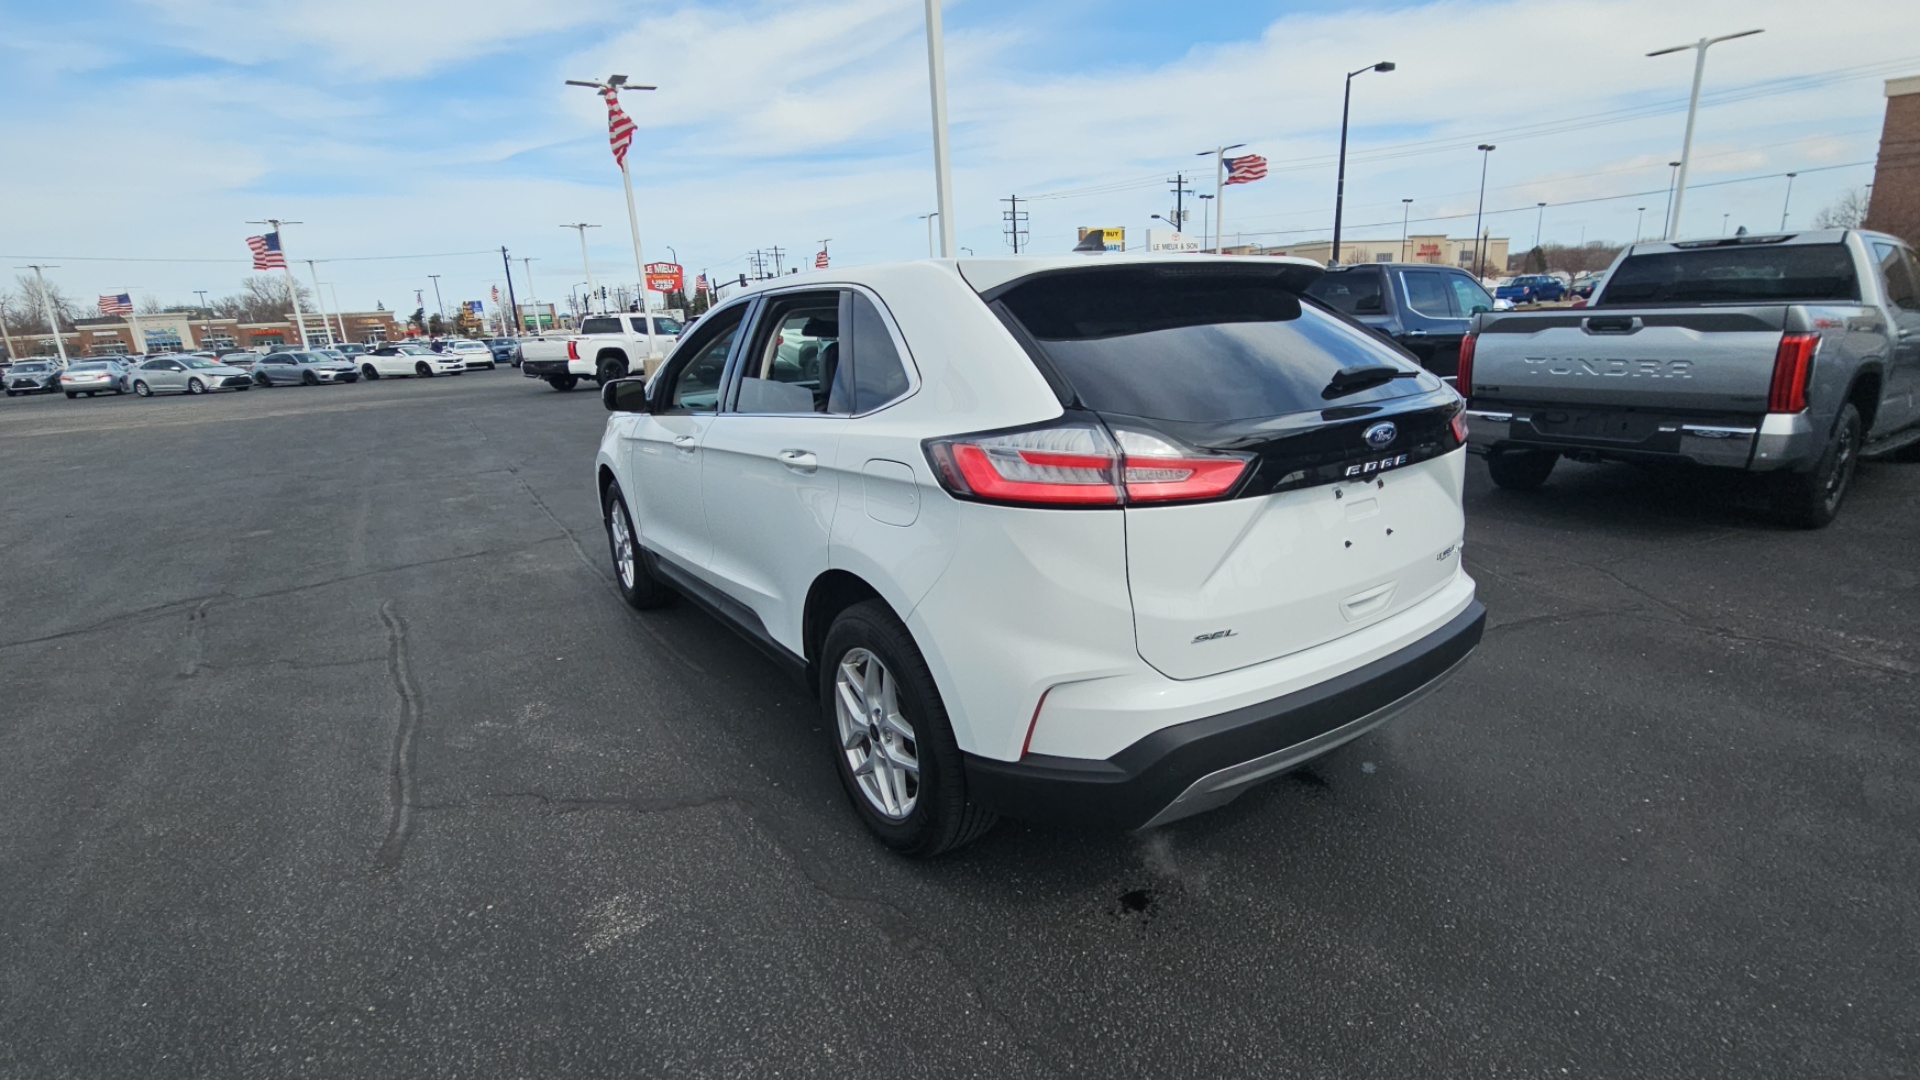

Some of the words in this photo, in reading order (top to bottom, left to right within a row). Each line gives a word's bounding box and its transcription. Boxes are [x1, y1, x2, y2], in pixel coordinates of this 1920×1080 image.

[1153, 243, 1160, 251] LE
[1186, 242, 1199, 250] SON
[654, 263, 679, 273] MIEUX
[1524, 357, 1694, 378] TUNDRA
[1374, 429, 1393, 442] Ford
[1345, 453, 1408, 477] EDGE
[1191, 629, 1239, 644] SEL
